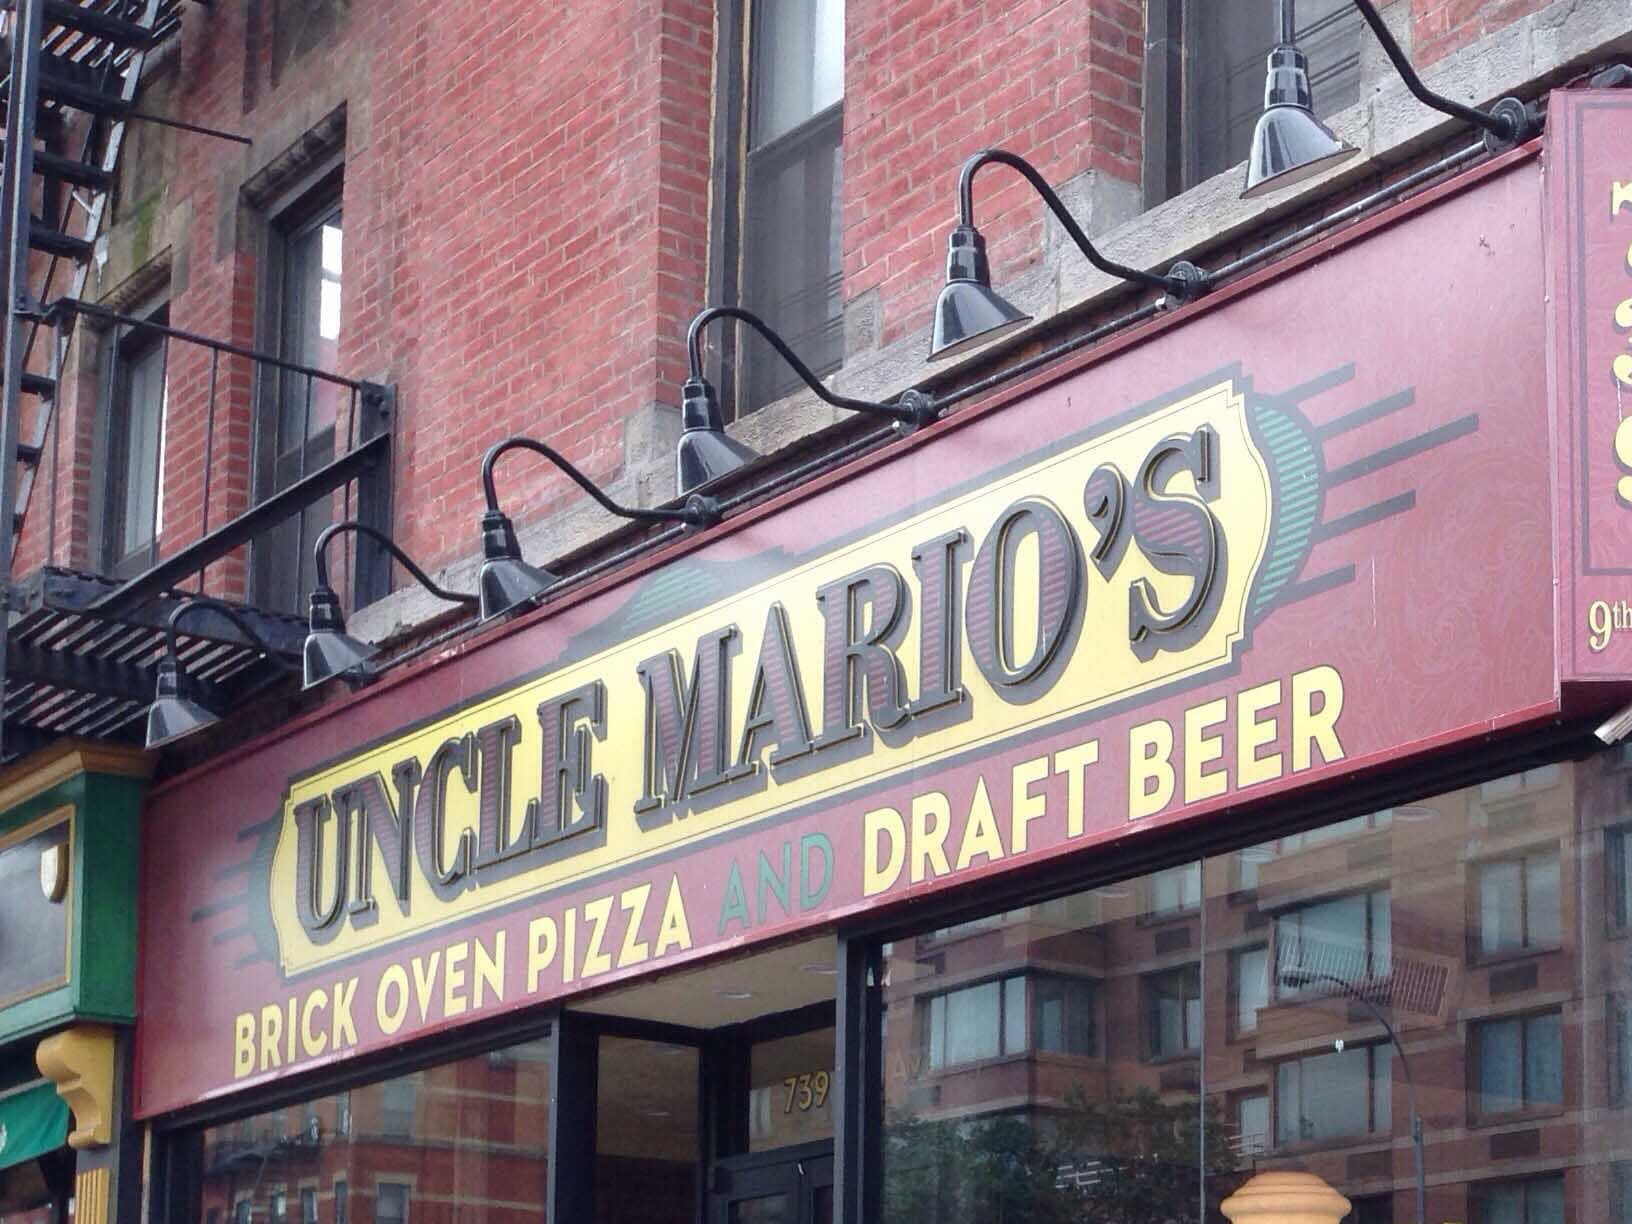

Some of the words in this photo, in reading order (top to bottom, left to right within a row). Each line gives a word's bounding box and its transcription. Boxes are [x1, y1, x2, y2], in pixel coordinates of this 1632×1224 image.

[234, 977, 359, 1078] BRICK
[376, 930, 508, 1036] OVEN
[527, 874, 693, 993] PIZZA
[717, 833, 836, 933] AND
[863, 739, 1101, 897] DRAFT
[1128, 665, 1346, 819] BEER
[291, 680, 608, 947] UNCLE
[633, 422, 1222, 831] MARIO'S
[784, 1071, 830, 1113] 739
